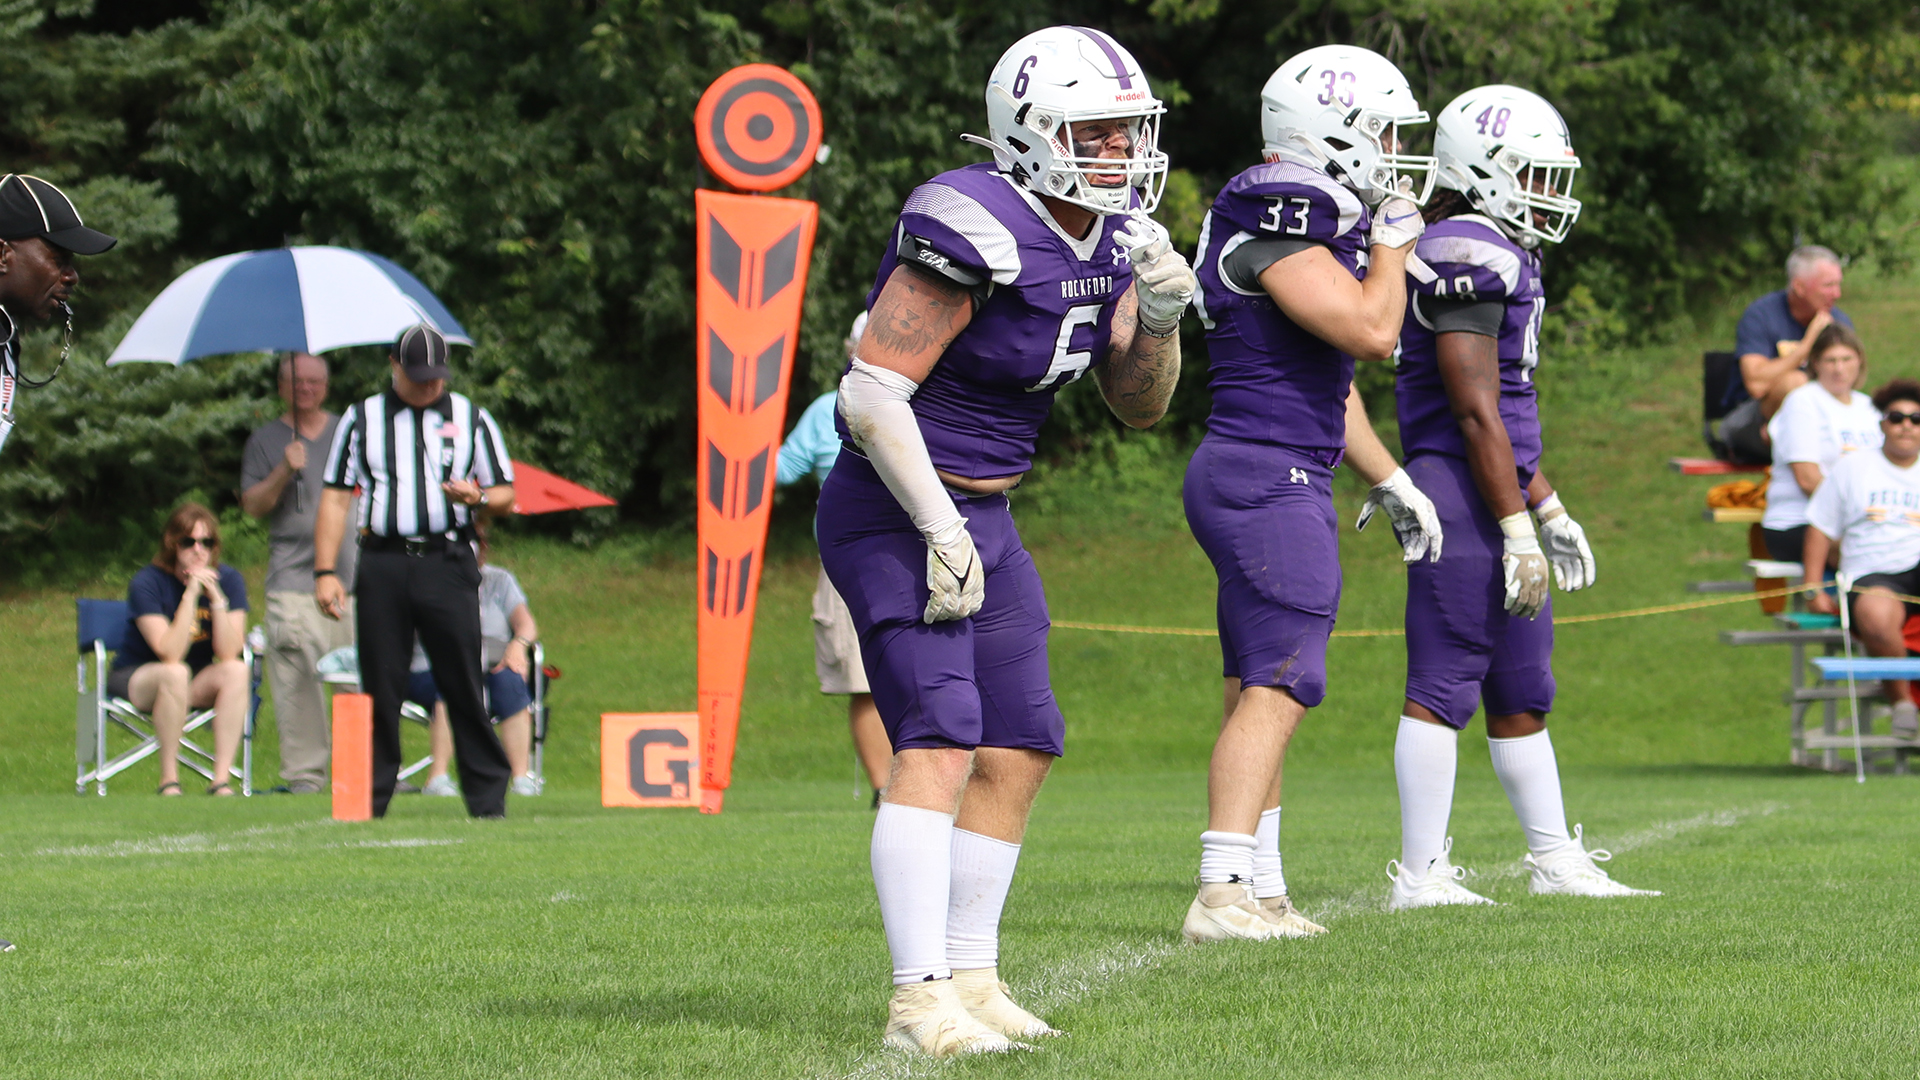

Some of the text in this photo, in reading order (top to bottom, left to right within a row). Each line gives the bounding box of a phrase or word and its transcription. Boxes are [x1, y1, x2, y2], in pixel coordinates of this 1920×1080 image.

[1012, 55, 1038, 99] 6
[1115, 91, 1146, 102] Riddell
[1317, 69, 1356, 108] 33
[1475, 105, 1511, 138] 48
[1258, 195, 1310, 236] 33
[1060, 276, 1113, 299] ROCKFORD
[1024, 303, 1104, 393] 6
[704, 699, 719, 783] FISHER
[627, 728, 690, 799] G
